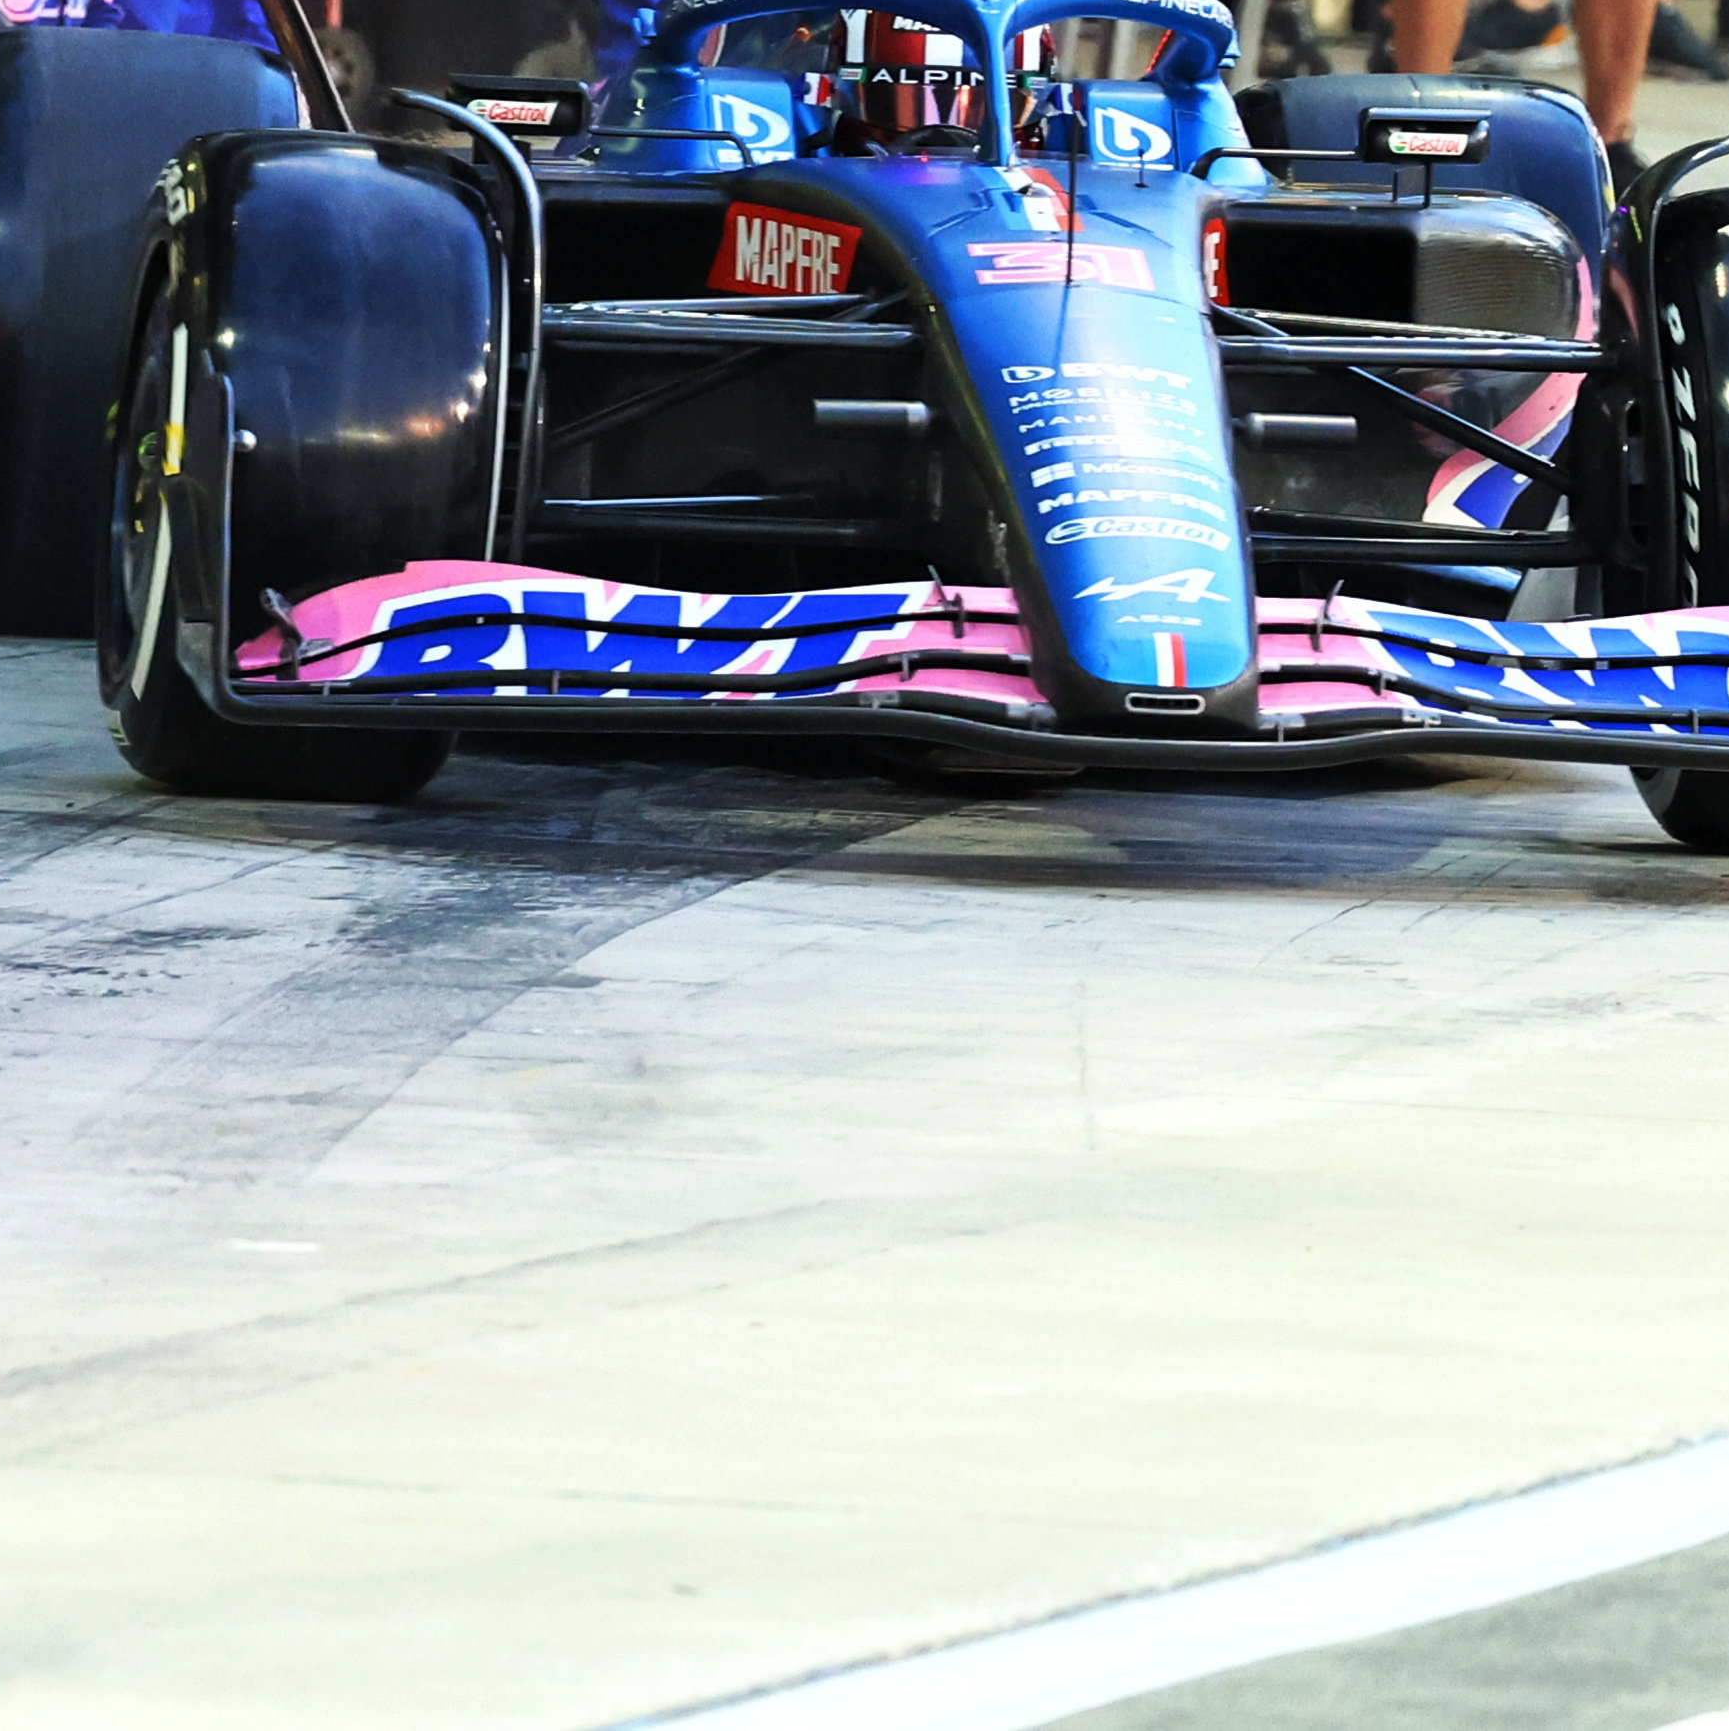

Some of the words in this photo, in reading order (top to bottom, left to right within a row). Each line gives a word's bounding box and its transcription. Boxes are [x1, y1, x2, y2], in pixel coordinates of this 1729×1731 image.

[488, 102, 551, 123] Castrol
[734, 208, 841, 295] MAPFRE
[966, 240, 1156, 291] 31
[1060, 362, 1193, 390] BWT
[1082, 459, 1222, 493] Microsoft
[1037, 489, 1229, 522] MAPFRE
[1092, 519, 1216, 544] Castrol
[362, 585, 912, 700] BWT
